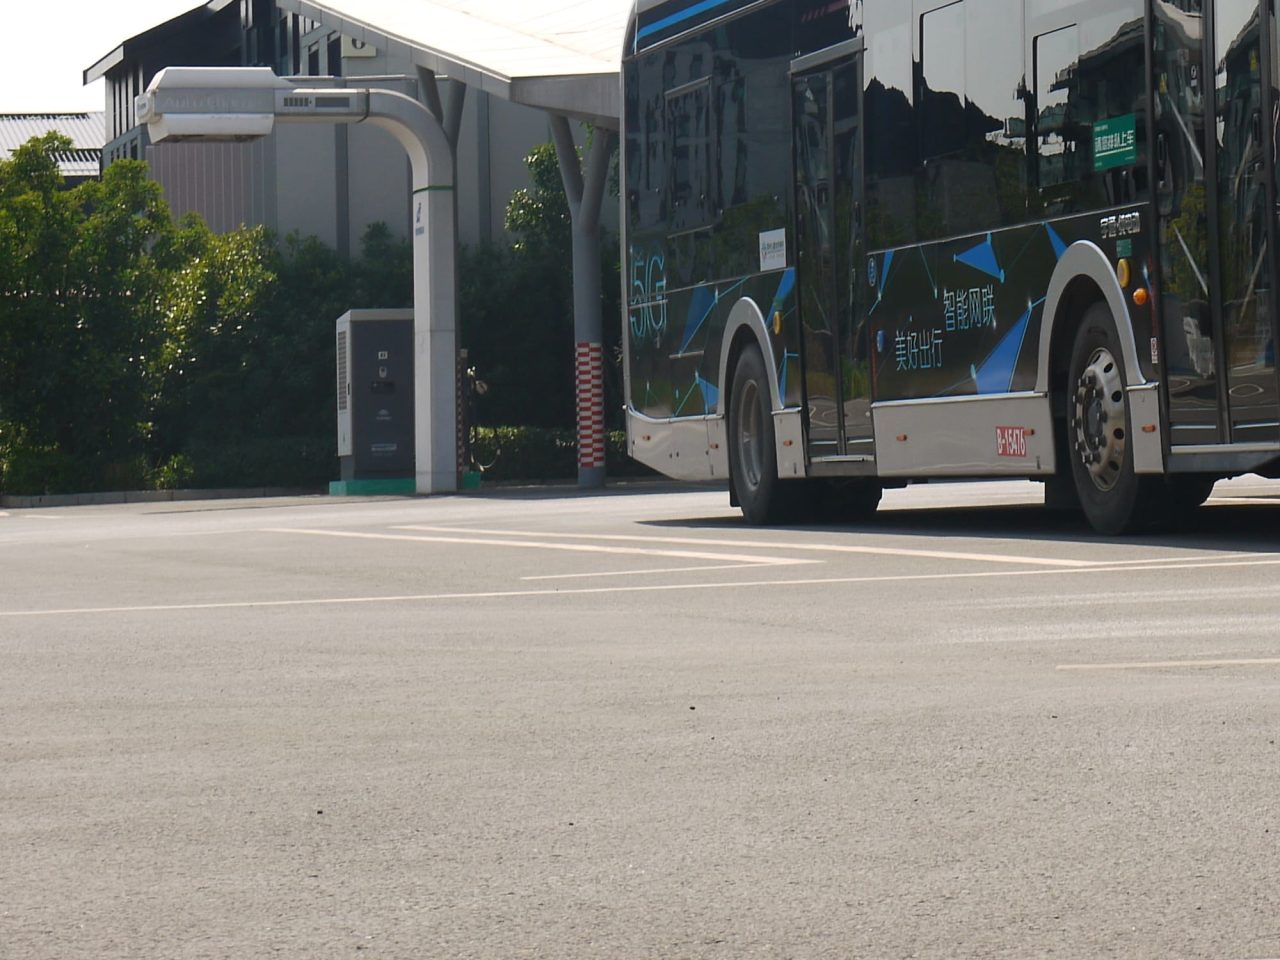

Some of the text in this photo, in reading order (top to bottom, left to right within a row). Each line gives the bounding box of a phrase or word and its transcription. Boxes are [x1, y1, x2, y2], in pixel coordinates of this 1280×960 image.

[629, 255, 667, 337] 5G
[943, 285, 995, 331] 智能网联
[895, 328, 943, 371] 美好出行
[997, 428, 1026, 455] B-15476
